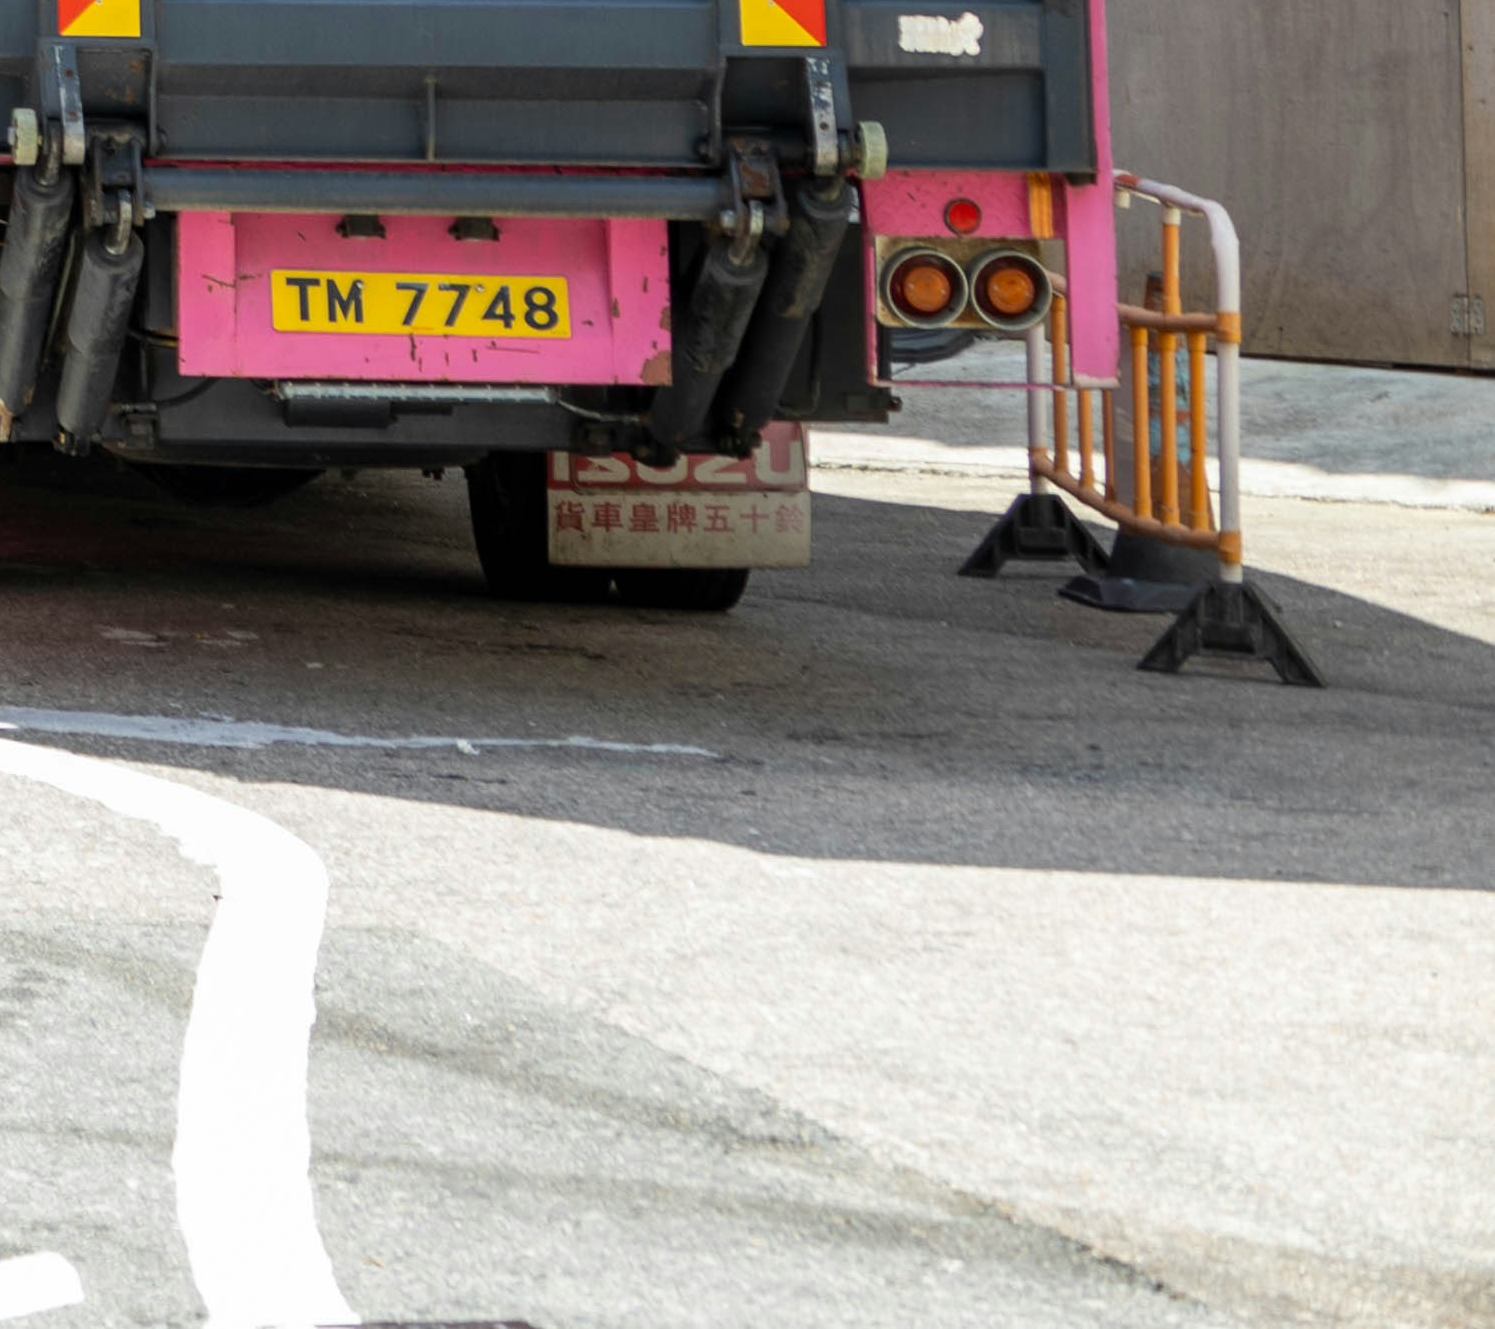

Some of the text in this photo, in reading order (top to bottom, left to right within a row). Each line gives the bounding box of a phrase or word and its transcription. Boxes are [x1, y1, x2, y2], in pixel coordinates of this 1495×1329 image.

[286, 277, 560, 331] TM 7748
[554, 500, 805, 534] 貨車皇牌五十鈴
